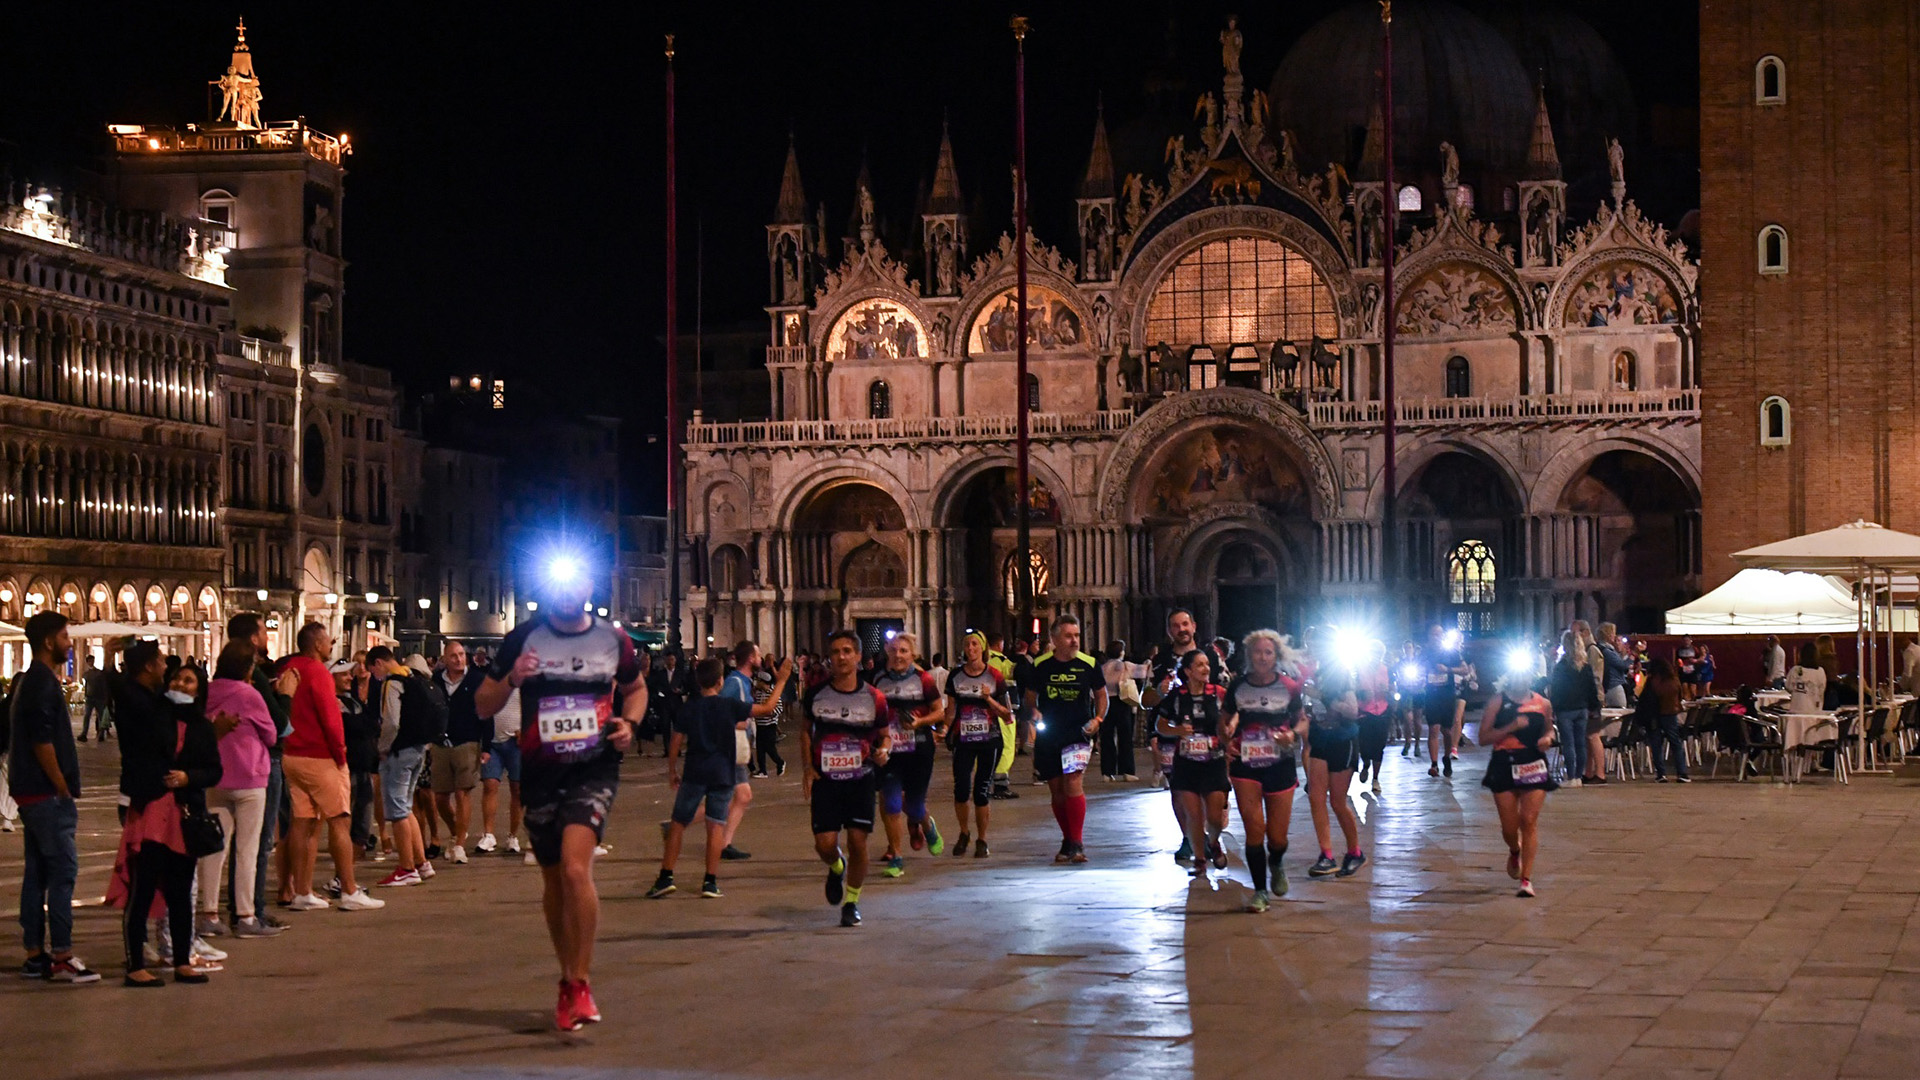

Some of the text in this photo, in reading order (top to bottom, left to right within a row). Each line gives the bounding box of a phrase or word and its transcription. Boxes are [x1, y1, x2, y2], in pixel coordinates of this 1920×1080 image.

[1050, 673, 1077, 682] CMP
[554, 718, 582, 734] 934
[965, 723, 984, 732] 1268
[554, 741, 586, 753] CMP
[829, 757, 855, 767] 3234
[830, 772, 854, 780] CMP
